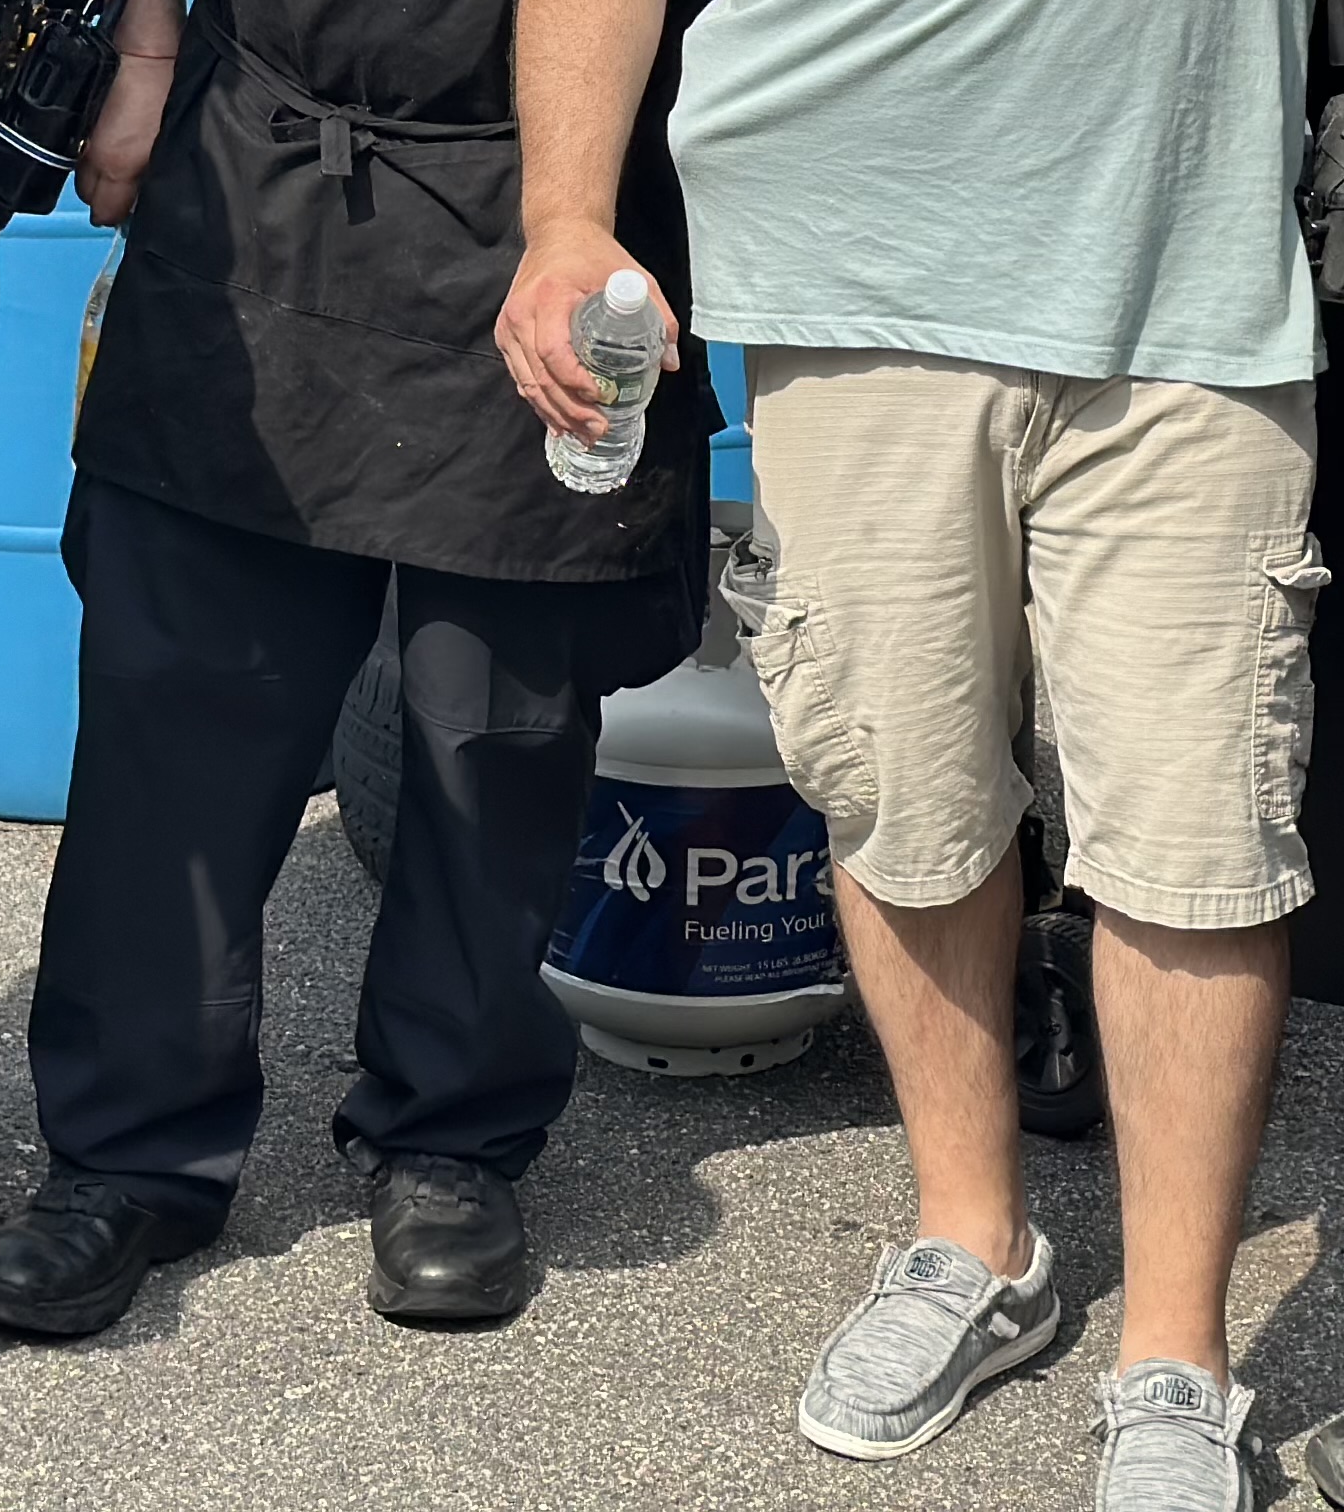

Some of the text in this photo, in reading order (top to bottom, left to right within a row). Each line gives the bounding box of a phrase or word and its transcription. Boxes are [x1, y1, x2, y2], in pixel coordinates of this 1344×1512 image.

[684, 912, 825, 943] Fueling Your
[909, 1256, 946, 1278] DUDE
[1151, 1381, 1196, 1406] DUDE
